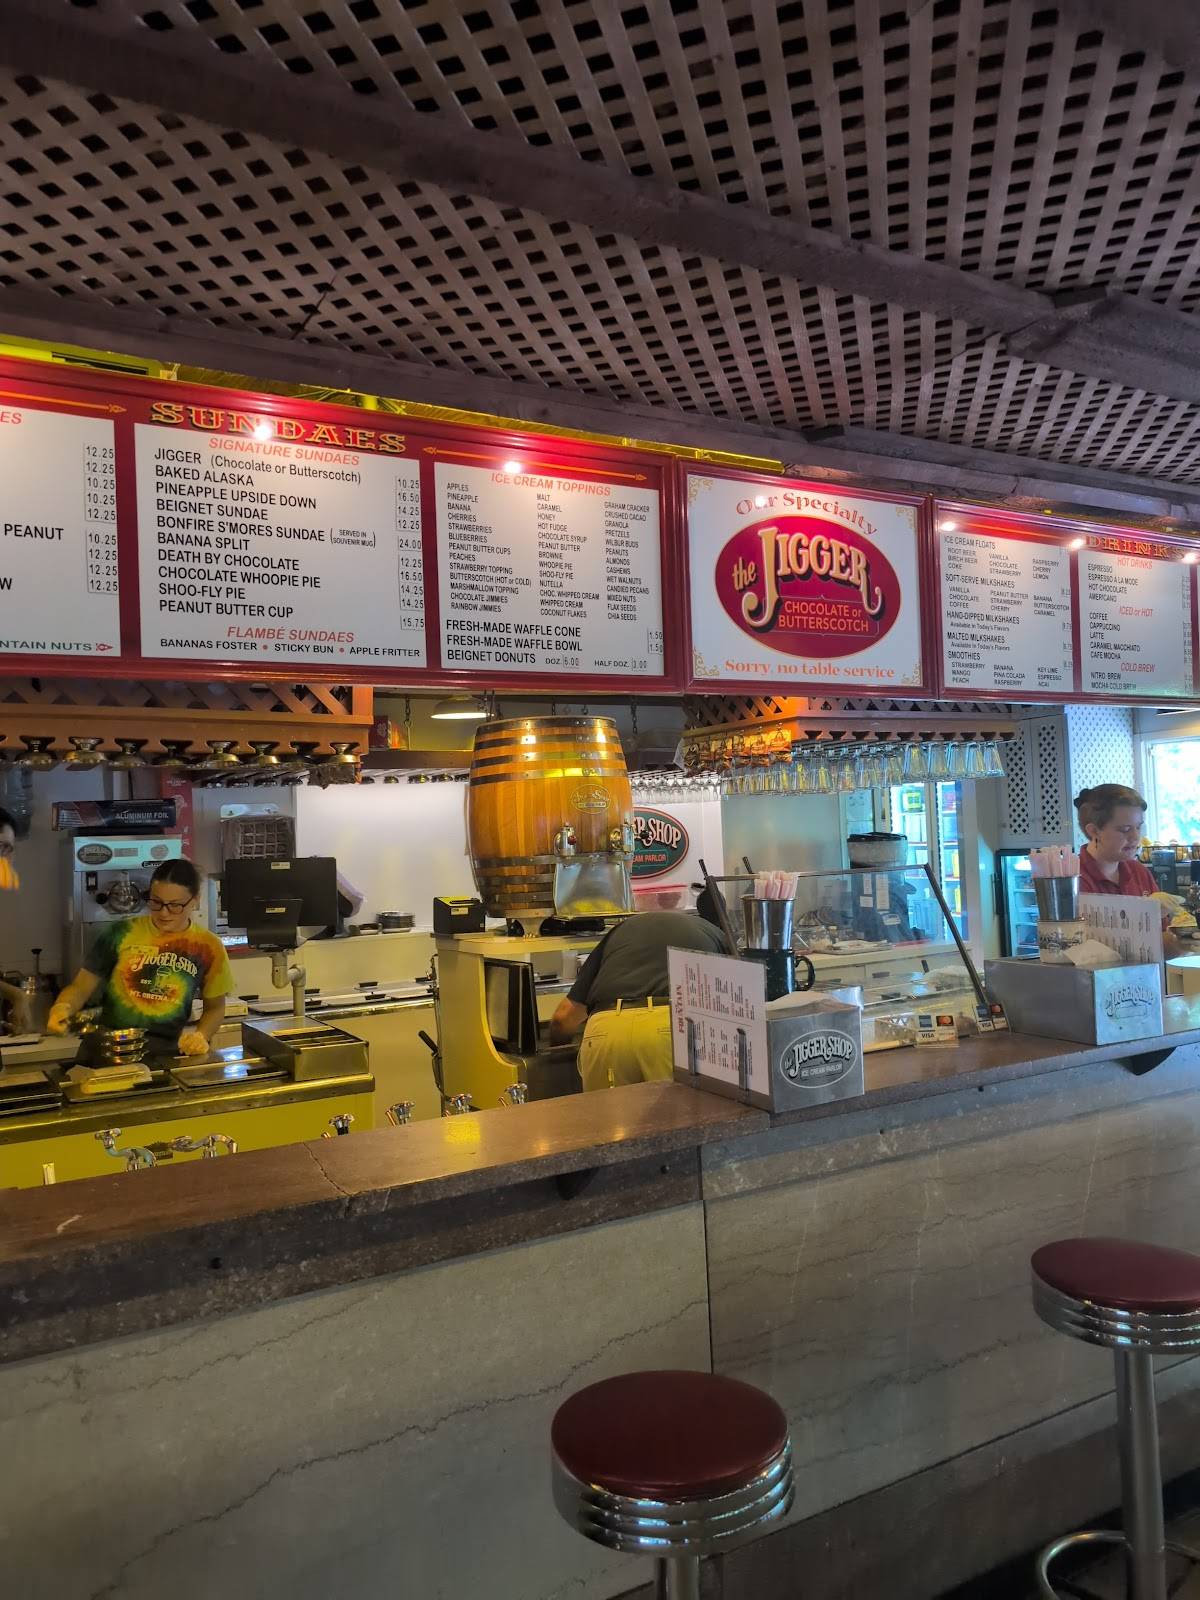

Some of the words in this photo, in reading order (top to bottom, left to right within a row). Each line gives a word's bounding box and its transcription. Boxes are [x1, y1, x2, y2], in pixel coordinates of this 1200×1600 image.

[151, 402, 407, 453] SUNDAES
[86, 446, 114, 459] 12.25
[208, 438, 290, 458] SIGNATURE
[295, 449, 360, 466] SUNDAES
[86, 461, 115, 474] 12.25
[154, 448, 202, 464] JIGGER
[211, 455, 272, 473] (Chocolate
[274, 464, 286, 474] or
[289, 464, 361, 484] Butterscotch)
[155, 465, 200, 481] BAKED
[203, 470, 254, 487] ALASKA
[87, 477, 115, 489] 10.25
[398, 478, 420, 489] 10.25
[447, 482, 469, 492] APPLES
[491, 473, 511, 484] ICE
[513, 475, 554, 489] CREAM
[556, 480, 611, 496] TOPPINGS
[87, 493, 115, 505] 10.25
[156, 482, 228, 500] PINEAPPLE
[231, 490, 277, 506] UPSIDE
[279, 494, 317, 509] DOWN
[447, 492, 479, 503] PINEAPPLE
[156, 499, 213, 515] BEIGNET
[217, 504, 268, 520] SUNDAE
[447, 502, 471, 512] BANANA
[537, 503, 562, 513] CARAMEL
[88, 508, 116, 520] 12.25
[448, 512, 477, 522] CHERRIES
[537, 513, 556, 521] HONEY
[782, 492, 878, 536] Specialty
[157, 516, 214, 532] BONFIRE
[218, 521, 273, 537] S'MORES
[276, 527, 325, 542] SUNDAE
[398, 520, 420, 530] 12.25
[448, 522, 492, 534] STRAWBERRIES
[4, 524, 64, 540] PEANUT
[89, 532, 117, 545] 10.25
[448, 532, 488, 543] BLUEBERRIES
[605, 529, 630, 538] PRETZELS
[157, 532, 212, 548] BANANA
[215, 536, 250, 550] SPLIT
[399, 538, 422, 549] 24.00
[954, 537, 974, 546] CREAM
[975, 540, 996, 549] FLOATS
[89, 548, 118, 561] 12.25
[449, 542, 472, 552] PEANUT
[472, 545, 495, 554] BUTTER
[495, 547, 511, 556] CUPS
[606, 547, 629, 556] PEANUTS
[158, 549, 201, 563] DEATH
[205, 552, 221, 564] BY
[224, 554, 300, 571] CHOCOLATE
[400, 558, 422, 569] 12.25
[449, 552, 476, 562] PEACHES
[89, 564, 118, 576] 12.25
[449, 562, 488, 573] STRAWBERRY
[488, 565, 513, 575] TOPPING
[1130, 559, 1153, 570] DRINKS
[158, 566, 238, 582] CHOCOLATE
[241, 571, 299, 586] WHOOPIE
[302, 576, 321, 588] PIE
[450, 572, 494, 583] BUTTERSCOTCH
[732, 557, 757, 591] the
[742, 526, 883, 628] JIGGER
[945, 573, 979, 584] SOFT-SERVE
[980, 577, 1015, 588] MILKSHAKES
[90, 579, 118, 592] 12.25
[159, 582, 222, 598] SHOO-FLY
[226, 587, 246, 599] PIE
[401, 584, 423, 595] 14.25
[450, 582, 494, 593] MARSHMALLOW
[495, 585, 519, 595] TOPPING
[540, 580, 563, 588] NUTELLA
[401, 598, 424, 609] 14.25
[451, 592, 485, 602] CHOCOLATE
[486, 594, 508, 604] JIMMIES
[160, 600, 212, 614] PEANUT
[216, 603, 265, 617] BUTTER
[268, 606, 293, 618] CUP
[784, 600, 849, 617] CHOCOLATE
[851, 608, 862, 617] or
[402, 618, 424, 628] 15.75
[778, 614, 869, 632] BUTTERSCOTCH
[946, 610, 984, 622] HAND-DIPPED
[985, 614, 1020, 624] MILKSHAKES
[227, 626, 286, 640] FLAMBÉ
[288, 629, 355, 643] SUNDAES
[446, 619, 512, 634] FRESH-MADE
[513, 623, 552, 636] WAFFLE
[554, 625, 581, 637] CONE
[446, 634, 512, 648] FRESH-MADE
[514, 638, 553, 651] WAFFLE
[555, 640, 582, 652] BOWL
[947, 631, 969, 641] MALTED
[970, 633, 1005, 643] MILKSHAKES
[51, 642, 92, 651] NUTS
[160, 639, 213, 649] BANANAS
[216, 640, 257, 650] FOSTER
[274, 643, 310, 653] STICKY
[313, 645, 334, 653] BUN
[349, 647, 380, 655] APPLE
[382, 648, 420, 657] FRITTER
[447, 650, 492, 662] BEIGNET
[495, 652, 536, 664] DONUTS
[947, 651, 981, 660] SMOOTHIES
[725, 658, 774, 674] Sorry,
[777, 663, 799, 674] no
[802, 662, 840, 676] table
[843, 665, 895, 679] service
[645, 818, 682, 848] SHOP
[789, 1036, 831, 1078] JIGGER
[827, 1035, 853, 1060] SHOP
